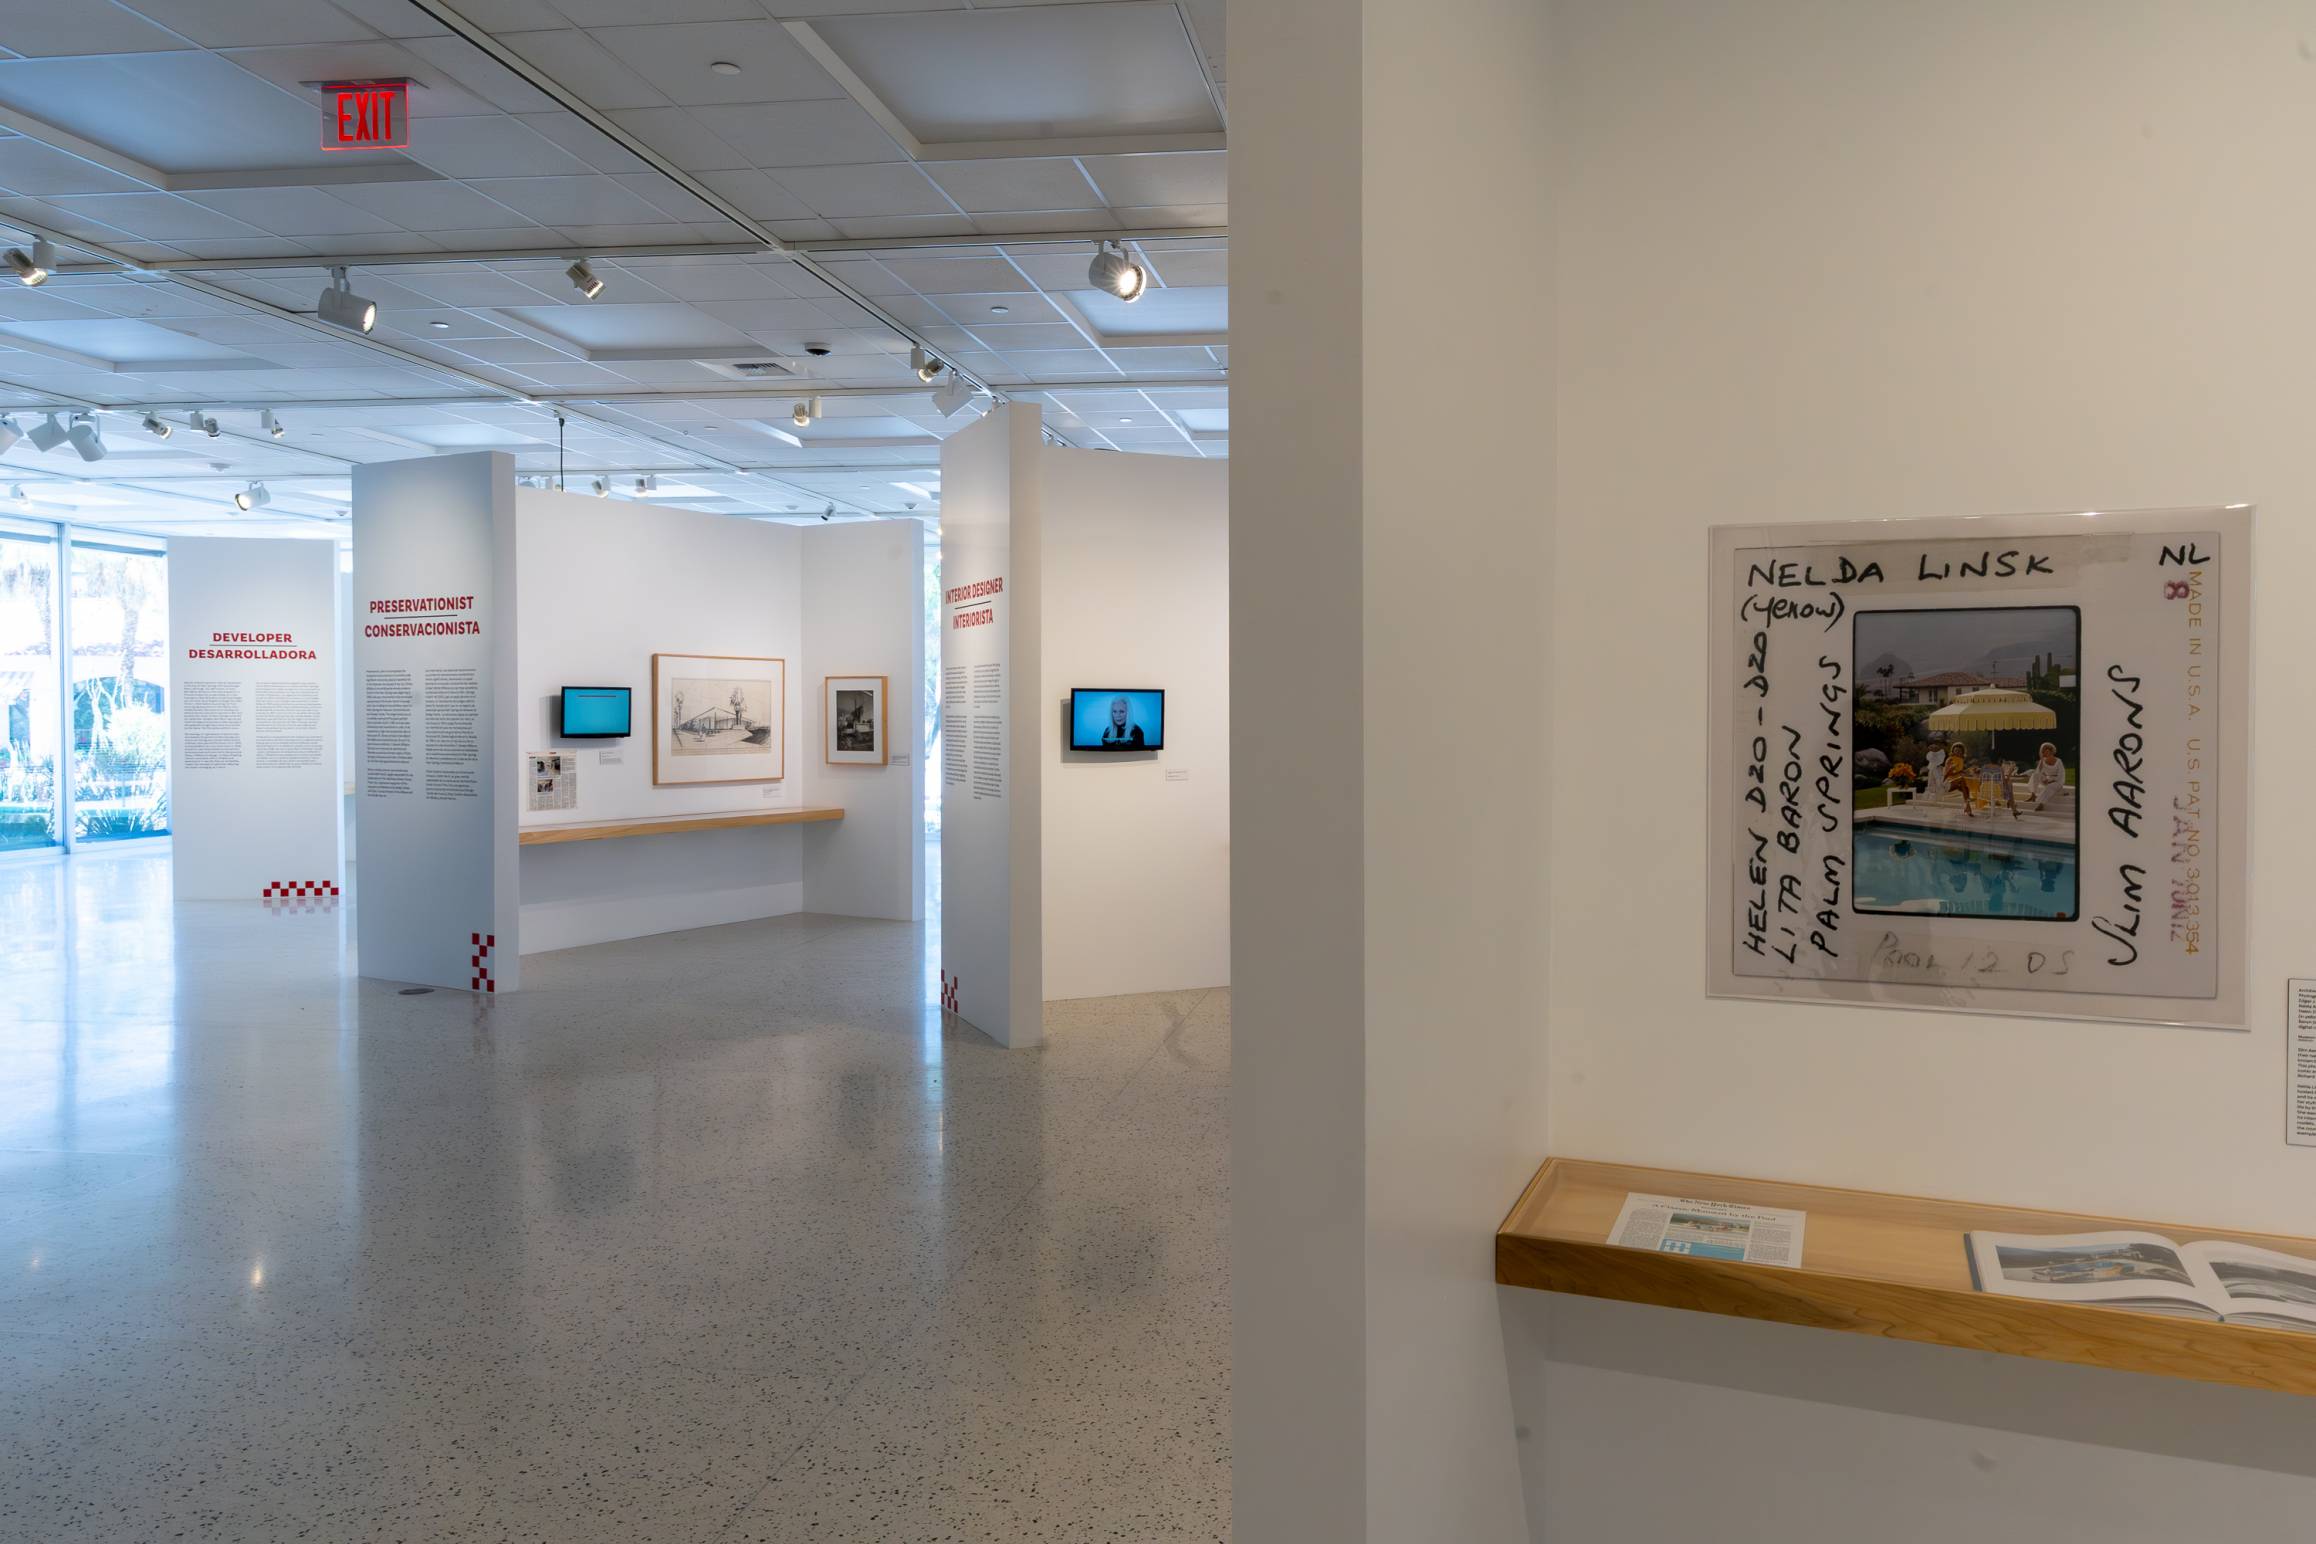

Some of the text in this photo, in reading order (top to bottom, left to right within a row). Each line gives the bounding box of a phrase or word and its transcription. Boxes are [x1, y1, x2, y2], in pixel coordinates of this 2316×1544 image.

[337, 91, 395, 142] EXIT
[2158, 542, 2211, 566] NL
[1748, 551, 2054, 587] NELDA LINSK
[945, 577, 1004, 604] INTERIOR DESIGNER
[2164, 579, 2190, 600] 8
[2188, 571, 2203, 628] MADE
[369, 596, 474, 613] PRESERVATIONIST
[364, 621, 480, 638] CONSERVACIONISTA
[952, 608, 994, 630] INTERIORISTA
[213, 632, 293, 643] DEVELOPER
[2188, 637, 2201, 655] IN
[189, 649, 317, 660] DESARROLLADORA
[2187, 665, 2201, 721] U.S.A.
[1810, 655, 1847, 957] PALM SPRINGS
[2091, 664, 2146, 966] SLIM AARONS
[1771, 725, 1802, 964] LITA BARON
[1742, 827, 1768, 956] HELEN
